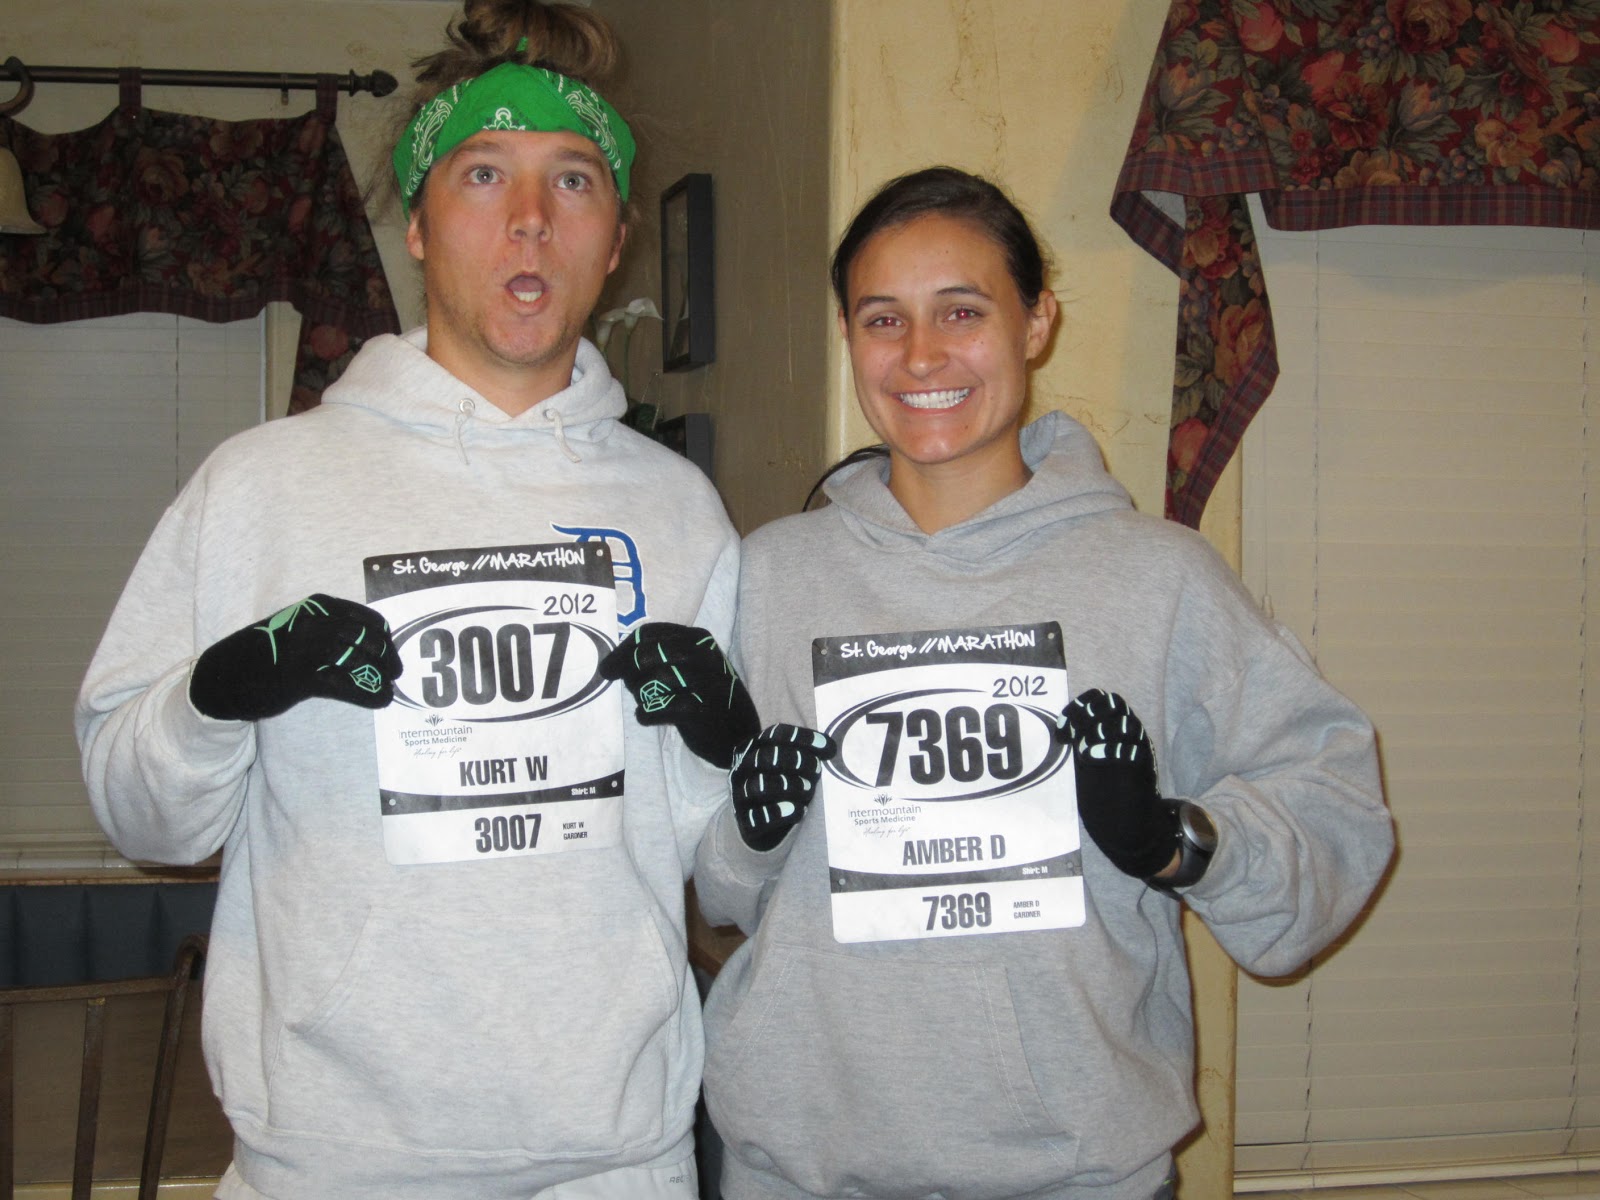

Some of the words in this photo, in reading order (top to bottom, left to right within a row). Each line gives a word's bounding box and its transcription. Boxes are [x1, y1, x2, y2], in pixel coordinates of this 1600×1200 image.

[393, 559, 418, 575] St.
[419, 556, 470, 577] George
[542, 592, 598, 616] 2012
[840, 642, 864, 659] St.
[866, 640, 917, 660] George
[419, 621, 571, 709] 3007
[991, 675, 1048, 698] 2012
[404, 738, 430, 747] Sports
[431, 735, 467, 745] Medicine
[865, 703, 1024, 788] 7369
[459, 757, 517, 787] KURT
[525, 755, 548, 782] W
[589, 786, 596, 795] M
[562, 822, 576, 830] KURT
[578, 821, 584, 829] W
[854, 818, 879, 826] Sports
[880, 815, 917, 824] Medicine
[474, 813, 542, 854] 3007
[563, 831, 588, 840] GARDNER
[902, 836, 983, 867] AMBER
[990, 834, 1006, 860] D
[1041, 866, 1048, 874] M
[922, 892, 992, 931] 7369
[1013, 901, 1034, 909] AMBER
[1035, 900, 1040, 908] D
[1013, 910, 1041, 919] GARDNER
